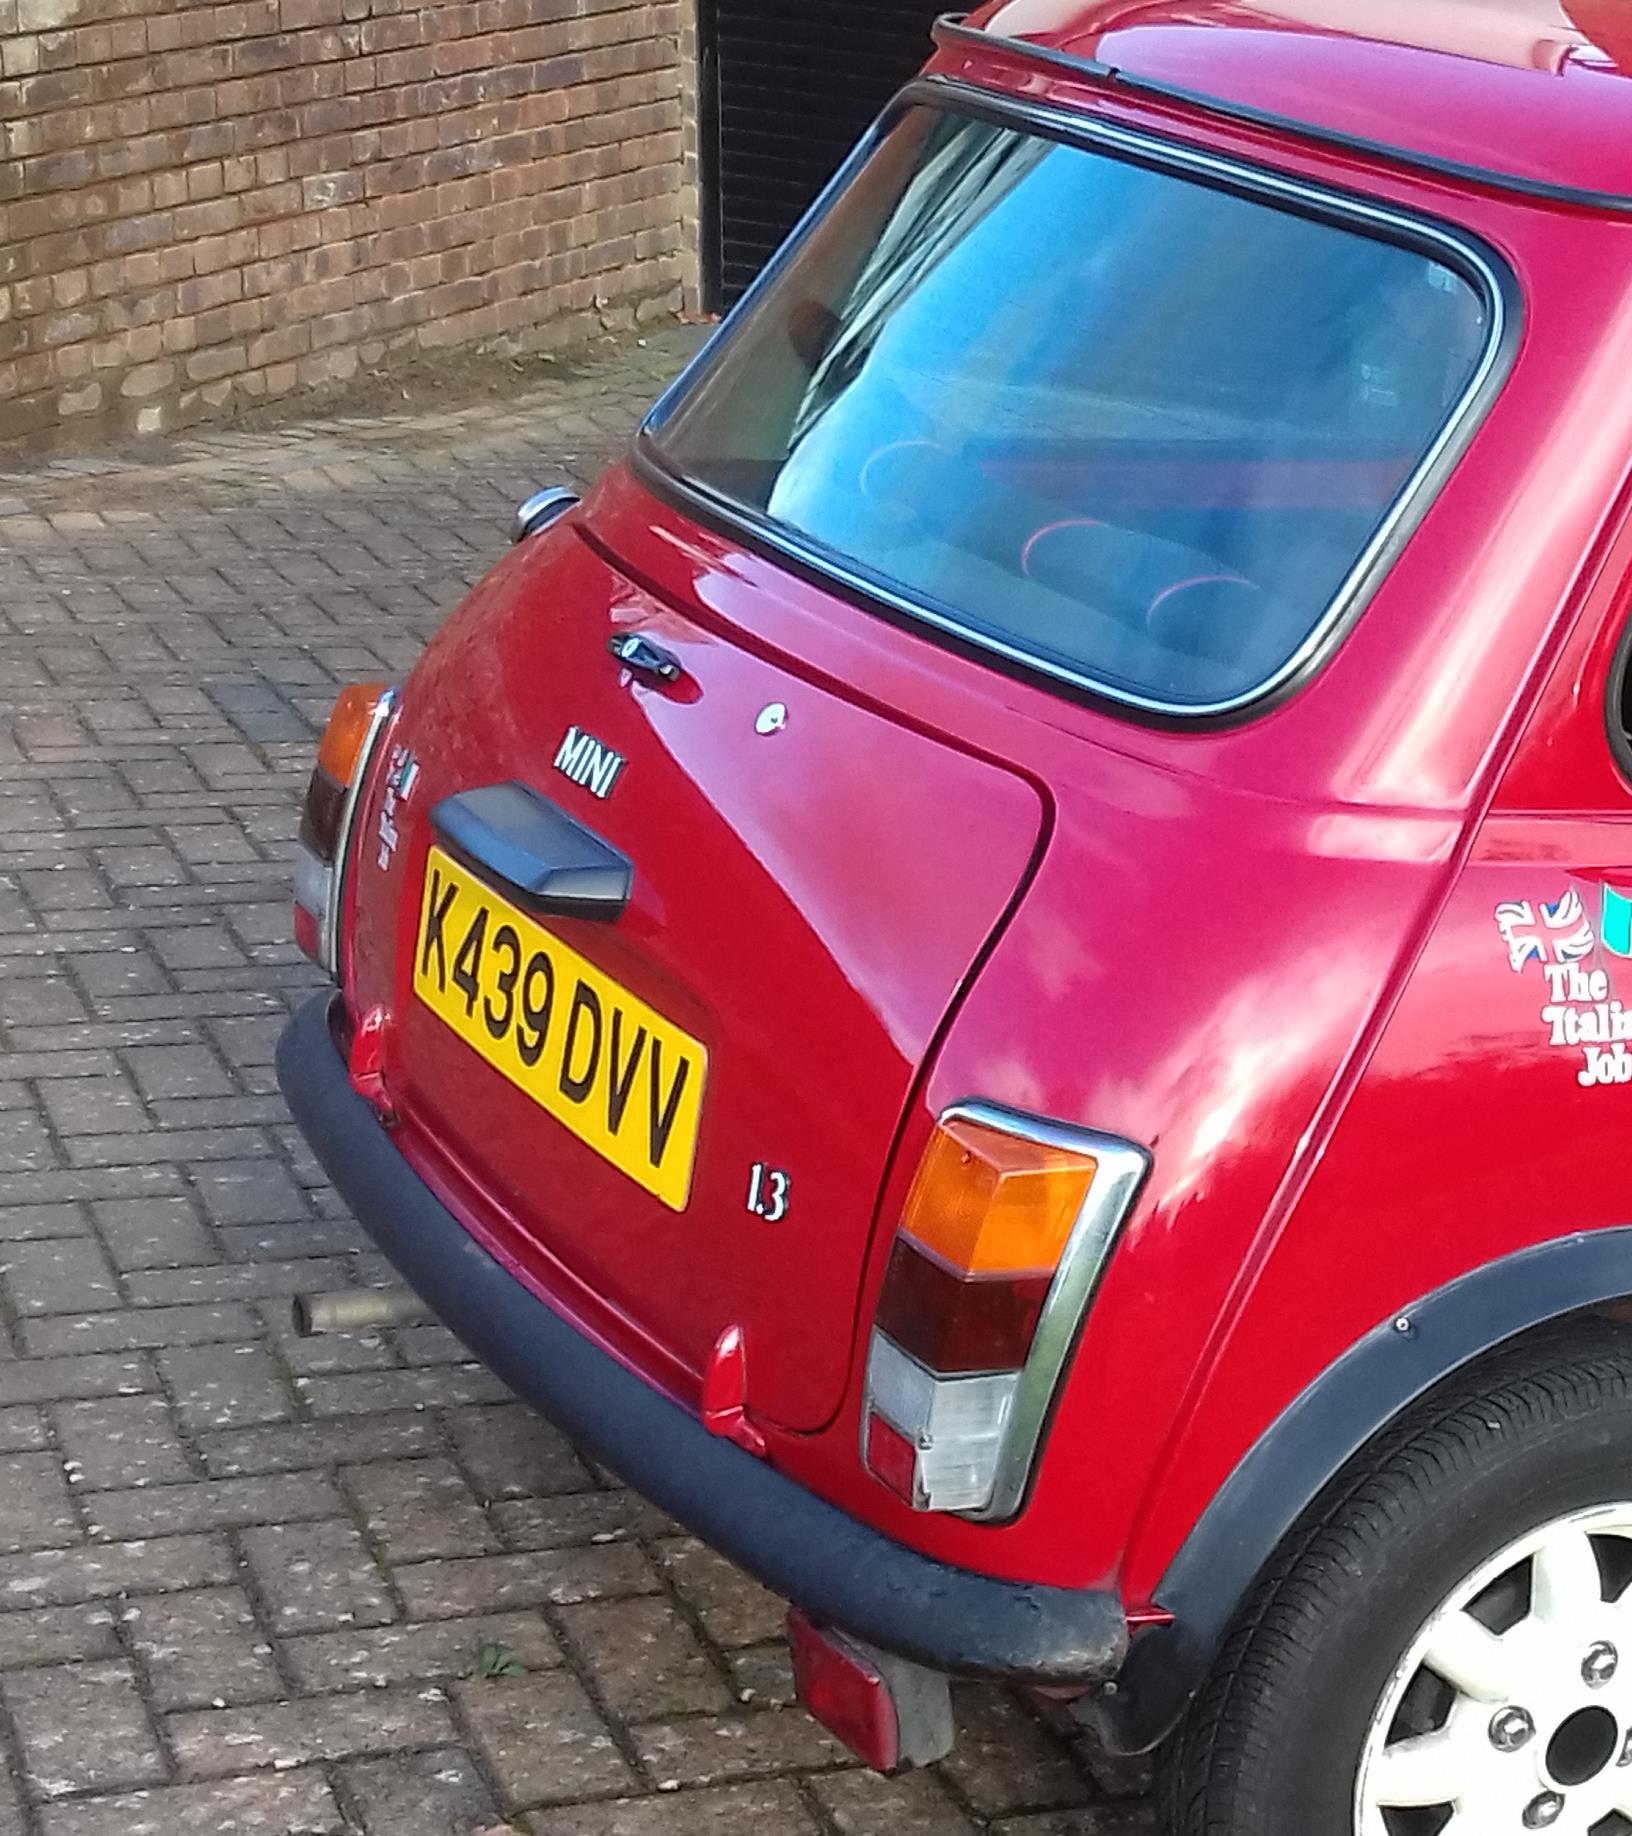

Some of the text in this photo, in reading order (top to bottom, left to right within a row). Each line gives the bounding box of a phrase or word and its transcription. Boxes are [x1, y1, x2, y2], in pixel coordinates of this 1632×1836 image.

[553, 726, 624, 798] MINI
[1543, 962, 1608, 1003] The
[421, 869, 690, 1169] K439 DVV
[747, 1163, 788, 1221] 1.3
